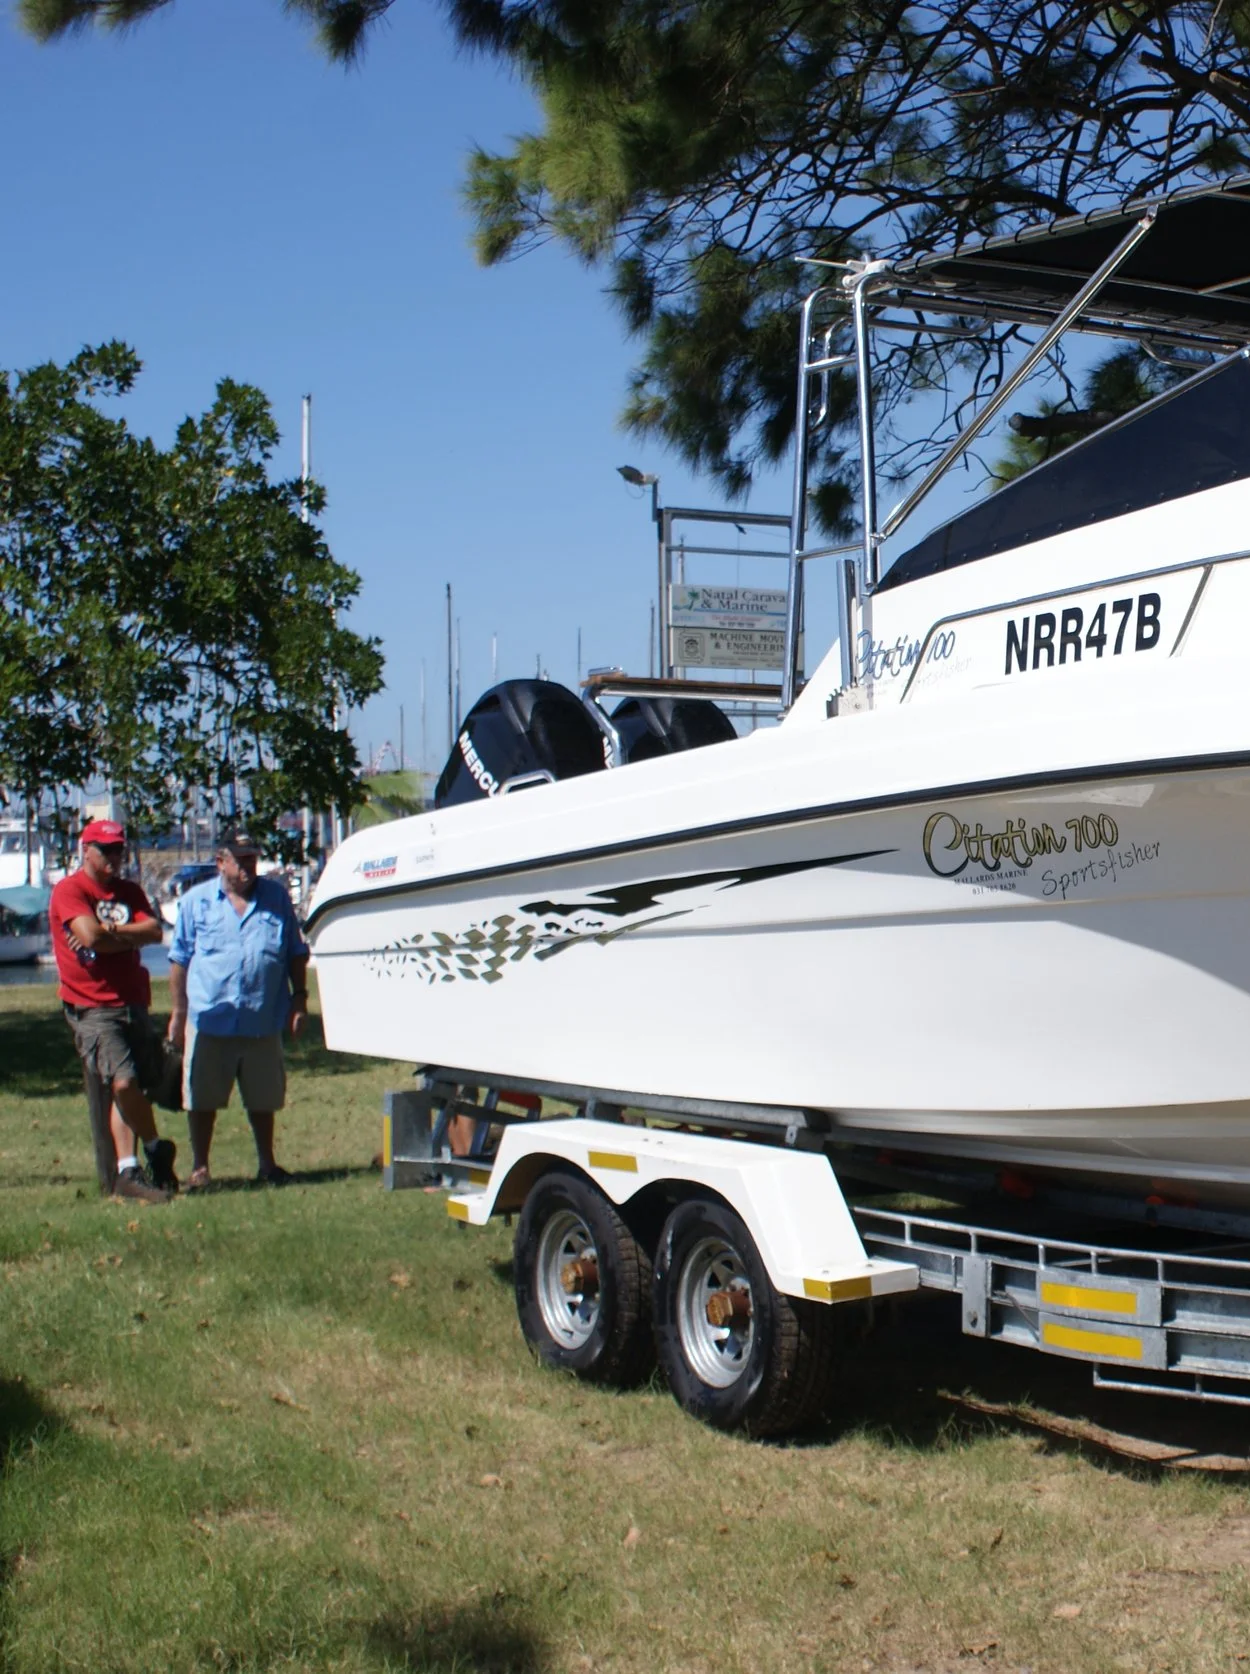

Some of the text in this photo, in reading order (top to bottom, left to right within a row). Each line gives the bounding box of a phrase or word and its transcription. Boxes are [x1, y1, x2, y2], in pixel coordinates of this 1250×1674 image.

[701, 588, 786, 603] Natal Carava
[700, 600, 768, 612] & Marine
[710, 632, 785, 644] MACHINE MOVI
[1004, 592, 1161, 676] NRR47B
[727, 642, 785, 652] ENGINEERIN
[923, 811, 1119, 877] Citation 700
[997, 869, 1028, 880] MARINE
[1041, 840, 1161, 900] Sportsfisher
